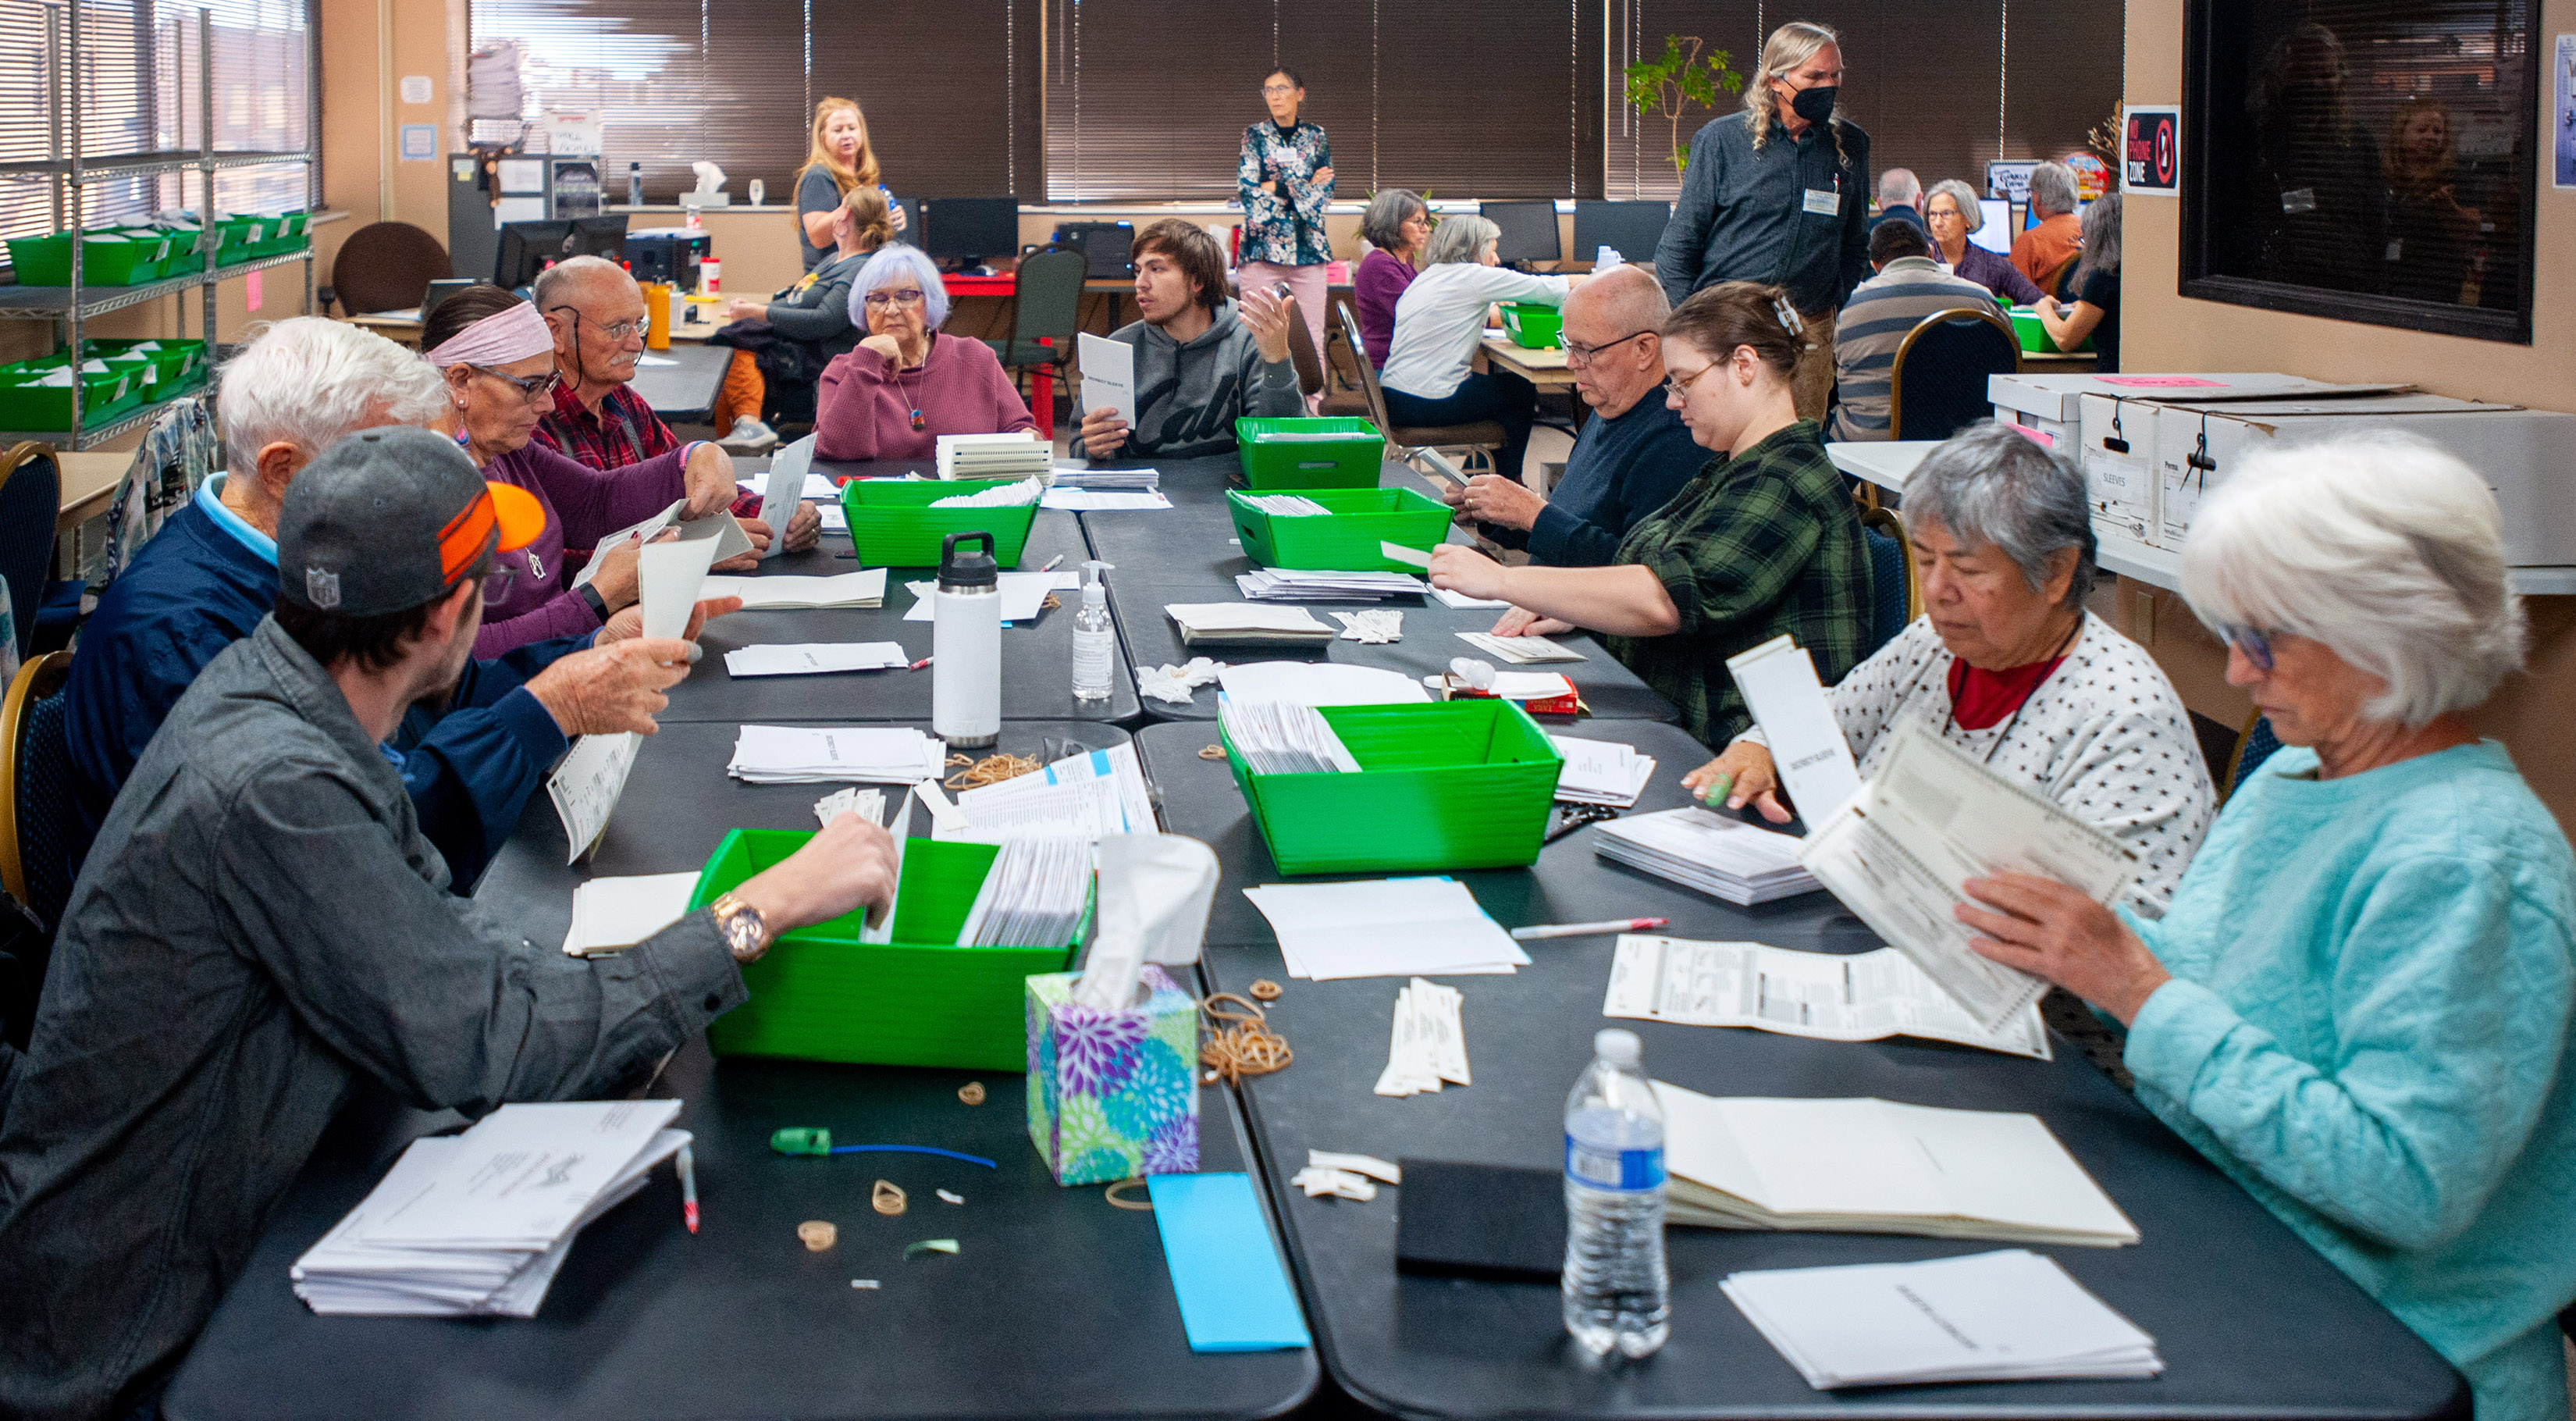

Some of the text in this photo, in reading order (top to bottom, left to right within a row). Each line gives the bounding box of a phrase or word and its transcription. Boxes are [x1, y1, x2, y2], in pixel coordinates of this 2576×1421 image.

[2129, 119, 2139, 140] NO
[2129, 140, 2151, 161] PHONE
[2128, 161, 2145, 183] ZONE
[2103, 472, 2126, 487] SLEEVES
